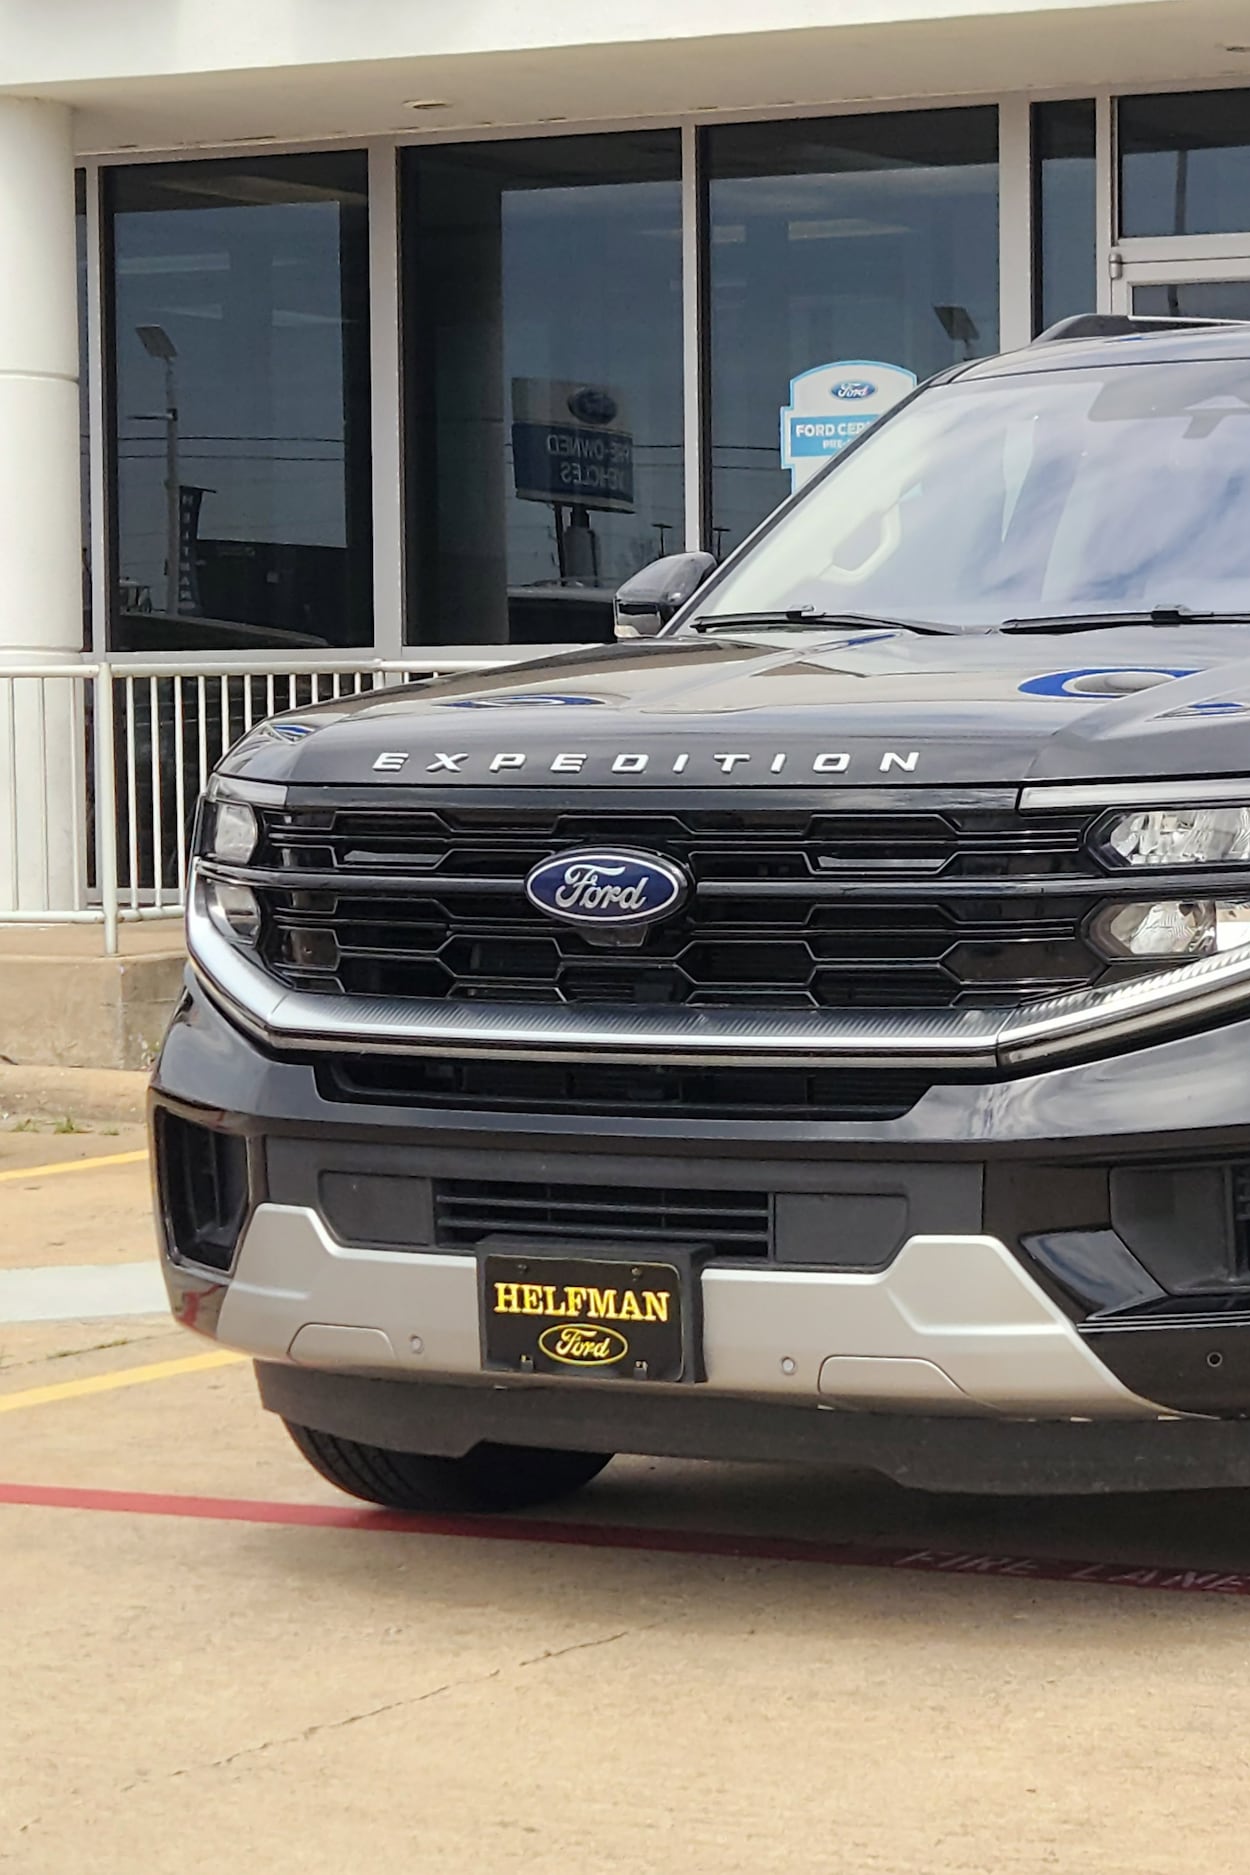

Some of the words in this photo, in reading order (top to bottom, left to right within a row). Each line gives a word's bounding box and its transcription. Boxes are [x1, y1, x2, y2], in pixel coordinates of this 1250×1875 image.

[796, 423, 836, 438] FORD
[372, 751, 920, 774] EXPEDITION
[555, 863, 649, 911] Ford
[494, 1283, 670, 1322] HELFMAN
[555, 1328, 611, 1358] Ford
[896, 1549, 1039, 1576] FIRE
